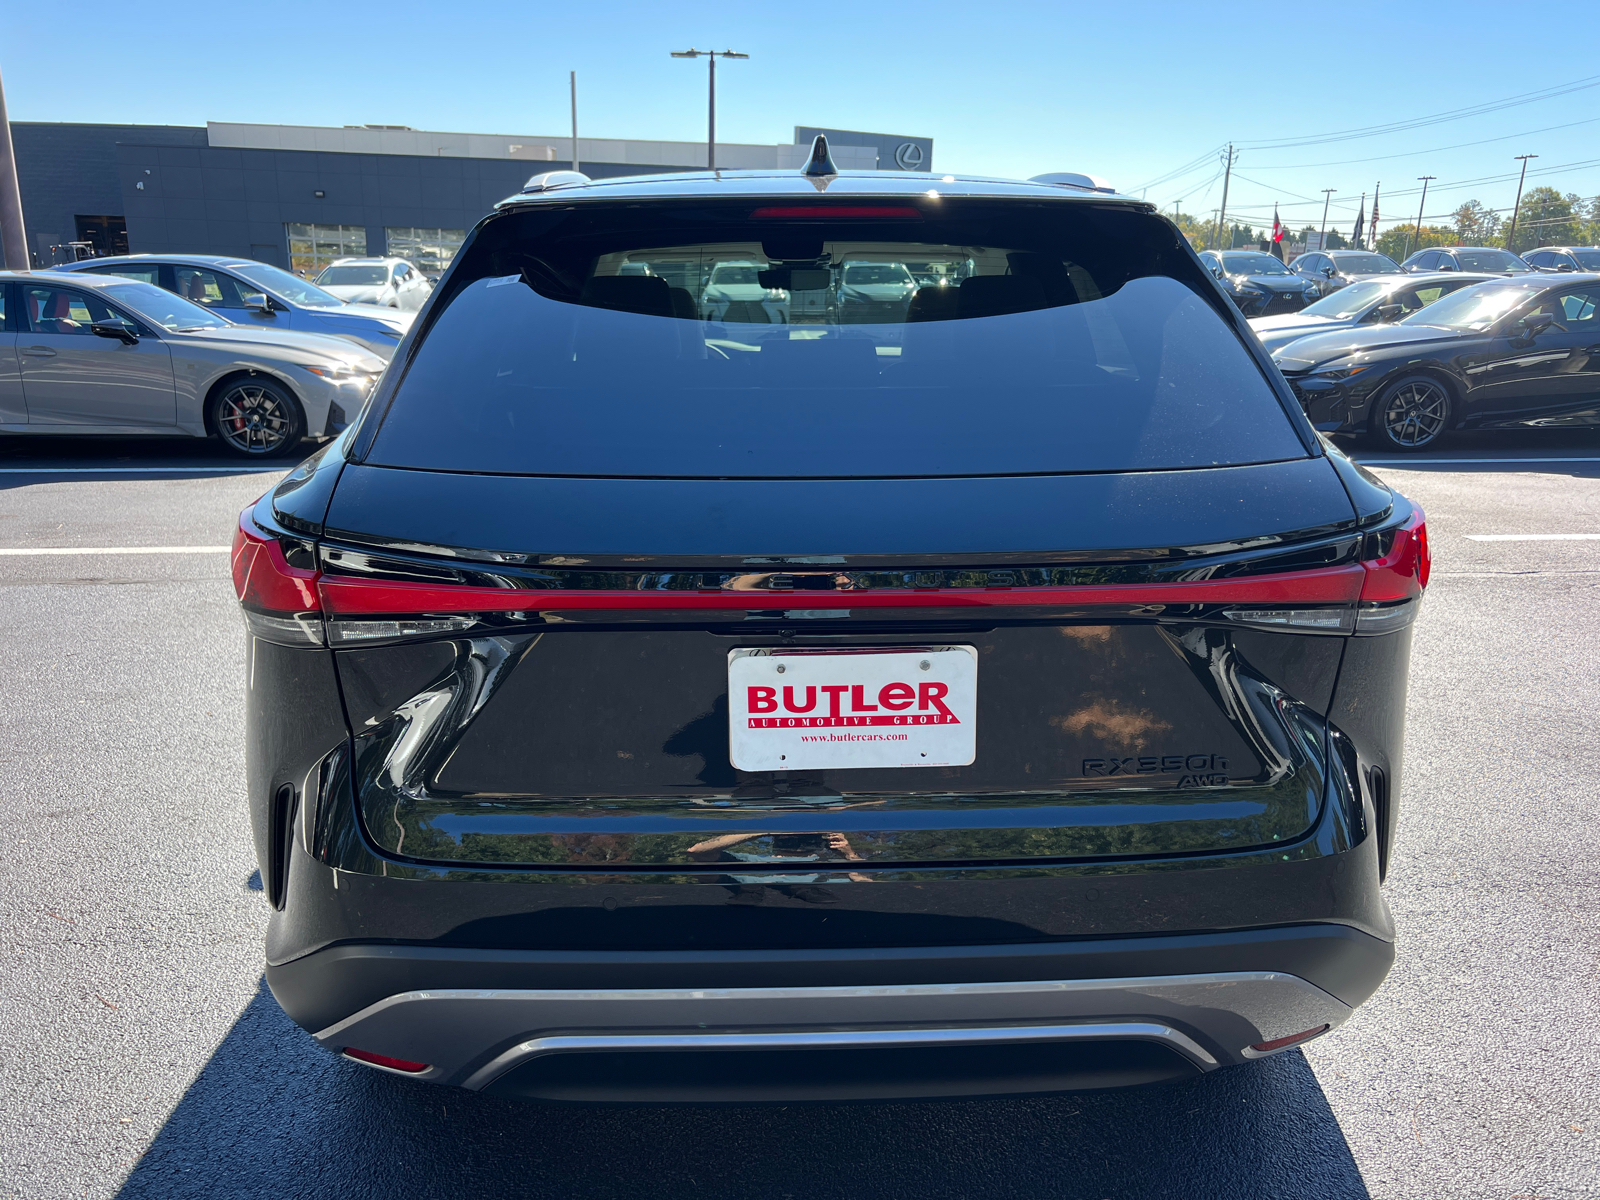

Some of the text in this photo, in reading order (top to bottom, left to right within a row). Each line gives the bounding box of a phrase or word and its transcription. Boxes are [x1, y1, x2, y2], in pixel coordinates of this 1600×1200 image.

[697, 570, 1014, 590] LEXUS
[749, 714, 953, 727] AUTOMOTIVE GROUP
[801, 732, 908, 743] www.butlercars.com
[1082, 754, 1230, 776] RX350h
[1177, 773, 1230, 788] AWD
